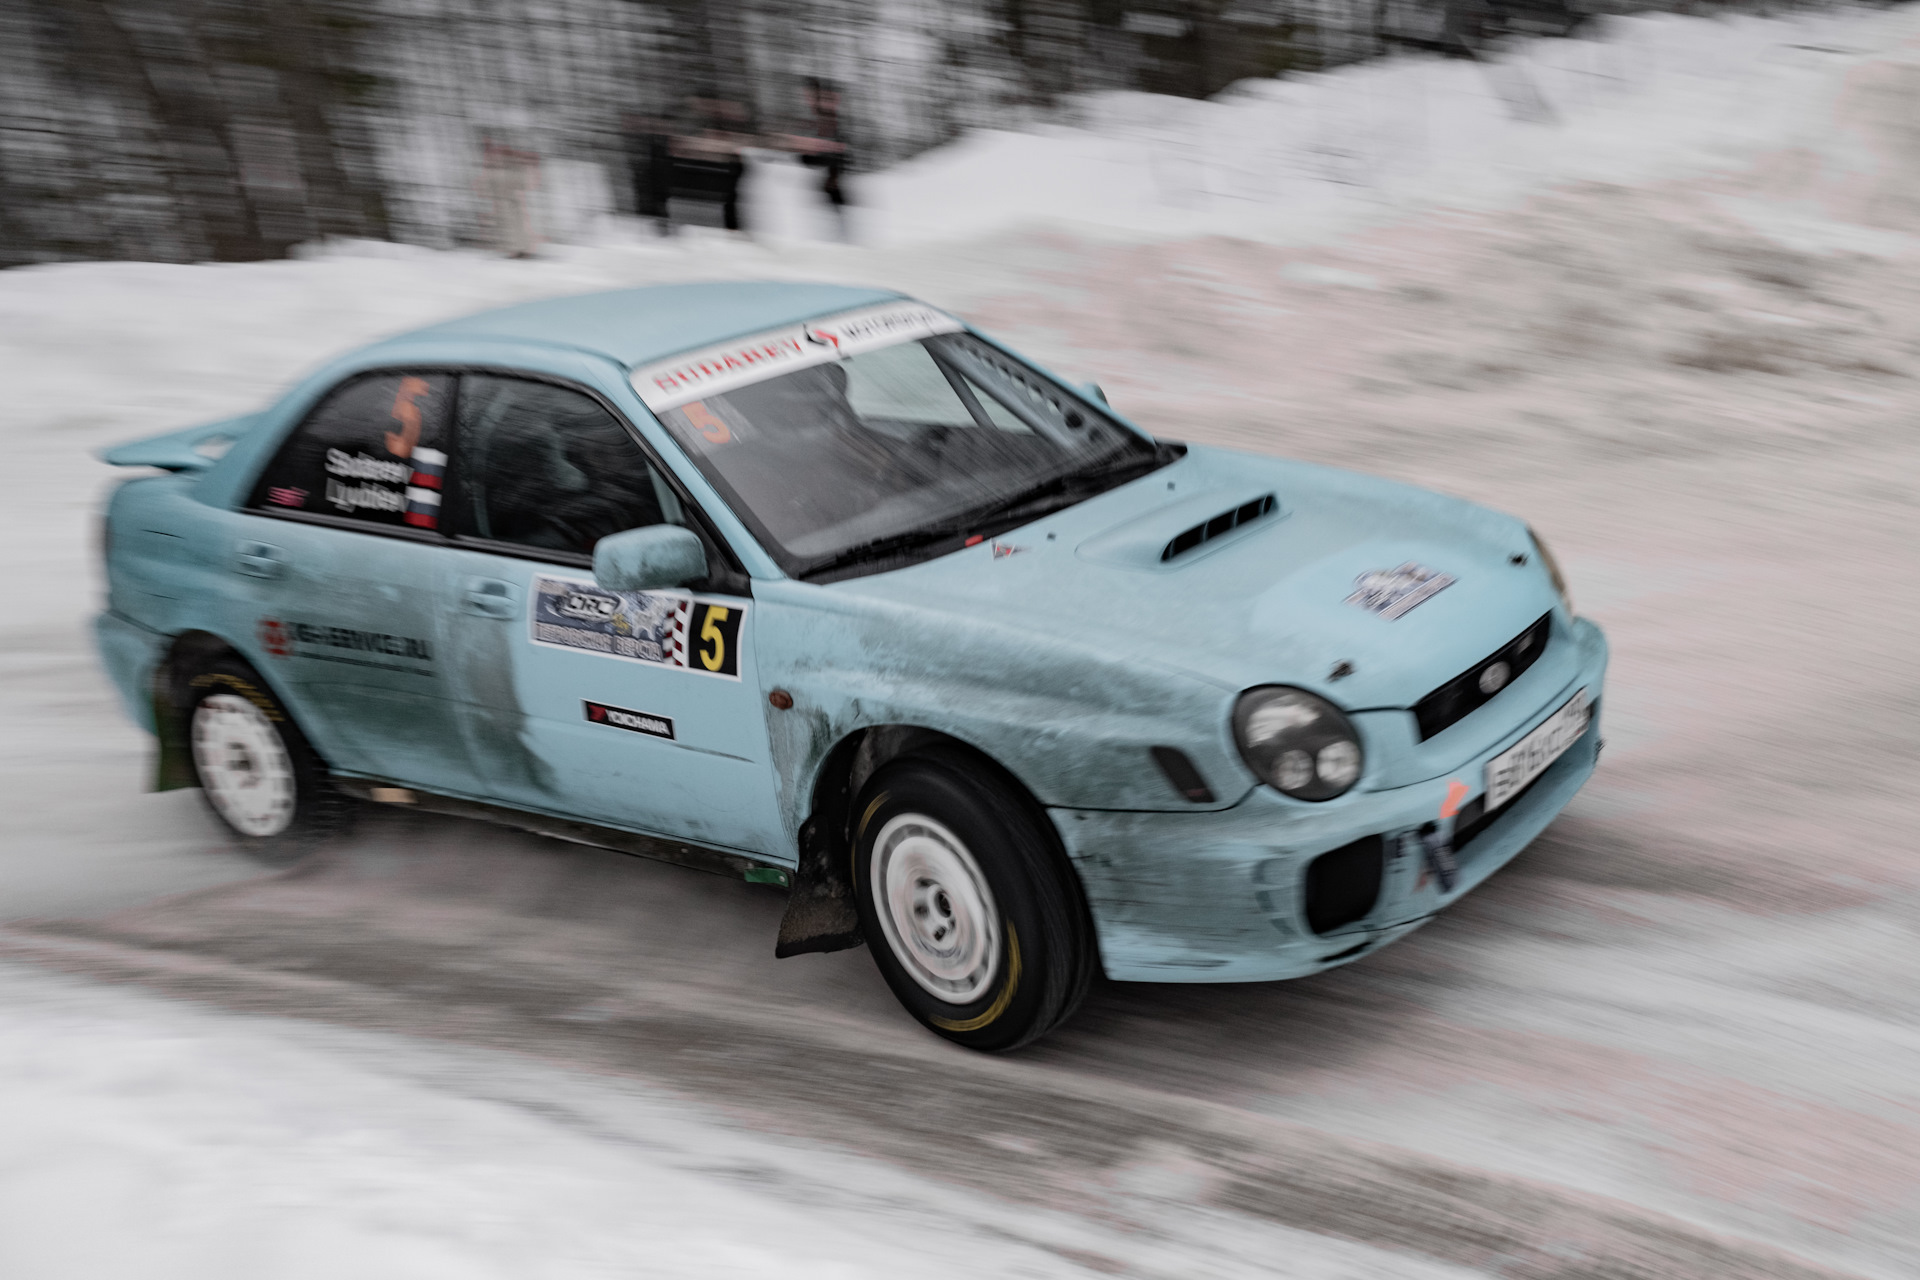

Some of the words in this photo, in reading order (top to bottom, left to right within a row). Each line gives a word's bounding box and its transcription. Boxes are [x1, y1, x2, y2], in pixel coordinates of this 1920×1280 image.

[385, 376, 430, 459] 5
[682, 401, 731, 444] 5
[700, 604, 729, 671] 5
